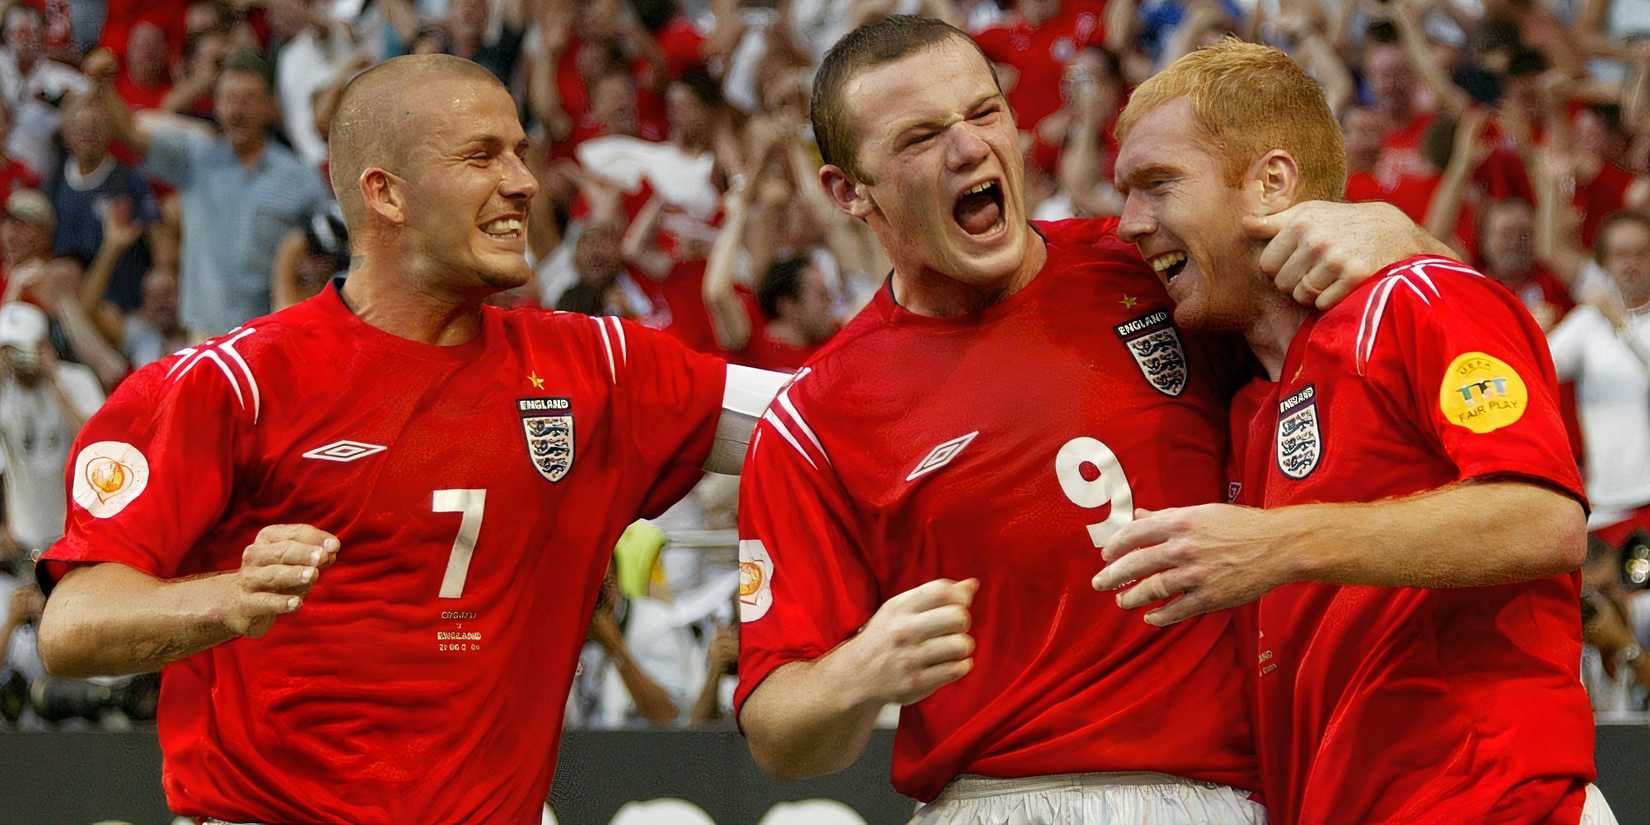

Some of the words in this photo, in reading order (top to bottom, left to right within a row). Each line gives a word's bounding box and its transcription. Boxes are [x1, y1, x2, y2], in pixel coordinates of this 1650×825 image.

[1118, 311, 1167, 336] ENGLAND
[519, 399, 569, 410] ENGLAND
[1458, 405, 1487, 423] FAIR
[1488, 400, 1519, 411] PLAY
[1055, 436, 1134, 548] 9
[432, 488, 487, 599] 7
